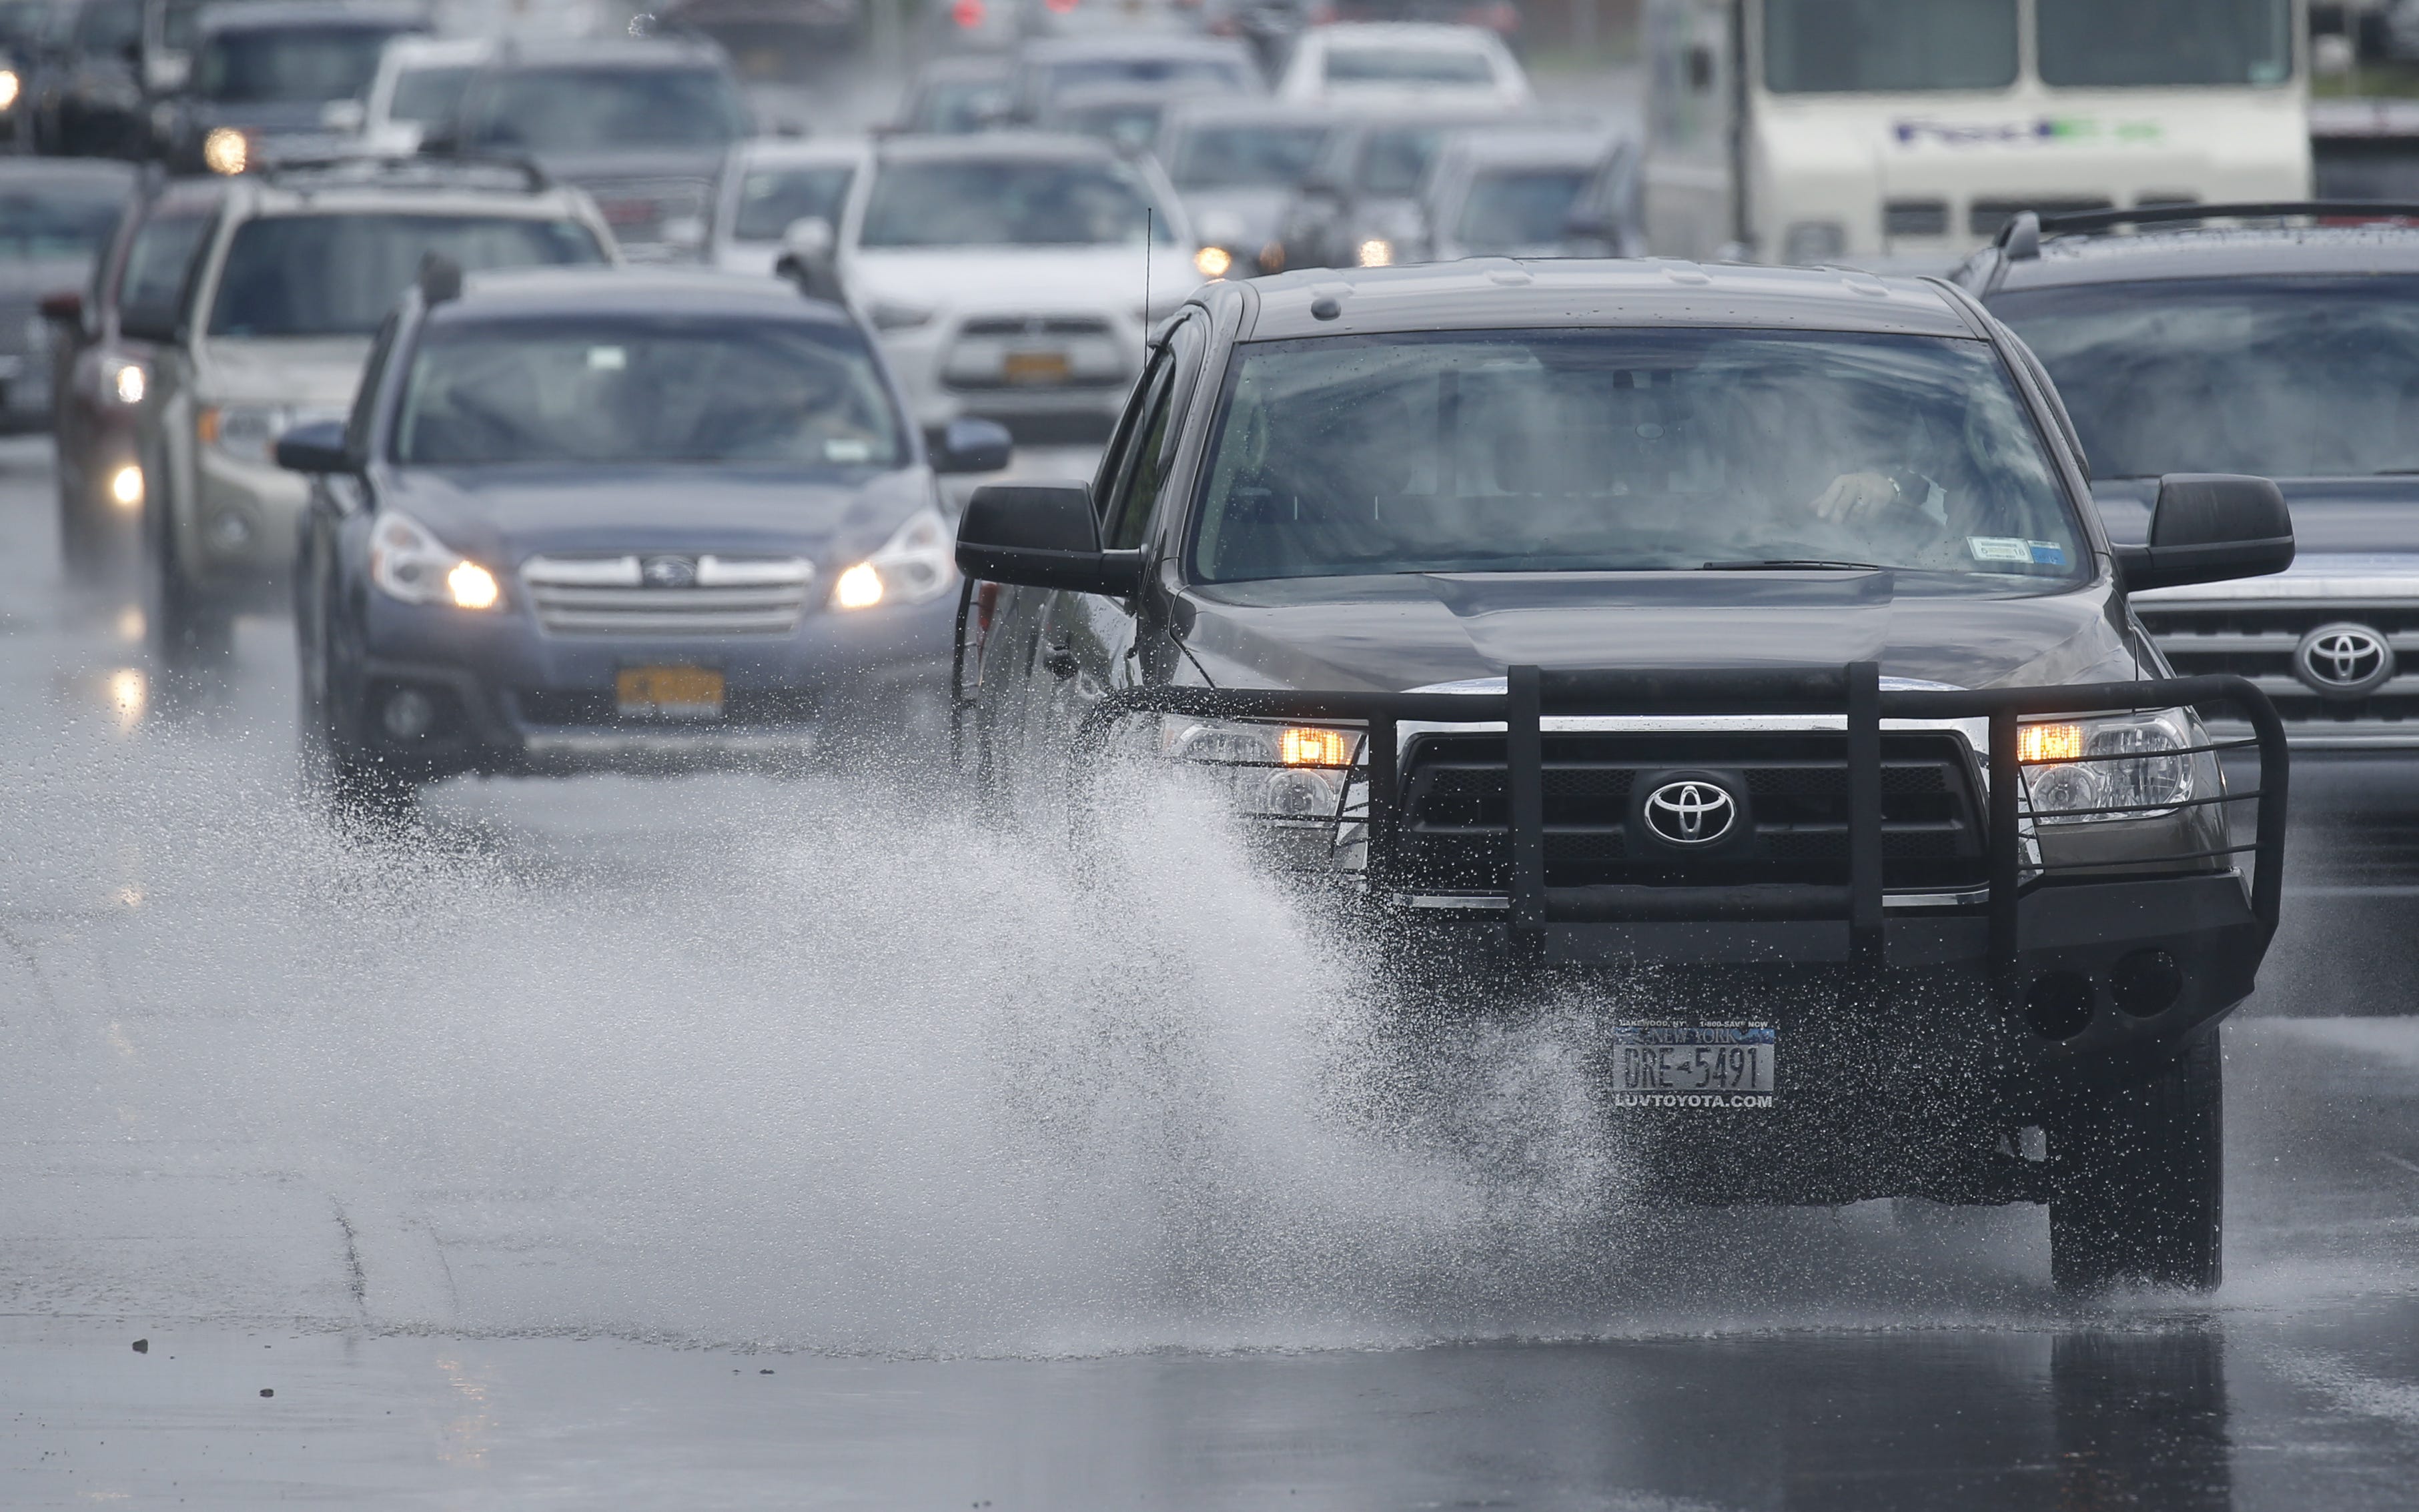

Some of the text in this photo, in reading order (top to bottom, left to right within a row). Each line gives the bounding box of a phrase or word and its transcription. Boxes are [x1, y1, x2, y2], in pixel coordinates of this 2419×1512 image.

[1652, 1028, 1737, 1044] NEW YORK
[1695, 1047, 1757, 1088] 5491
[1615, 1095, 1772, 1108] LUVTOYOTA.COM
